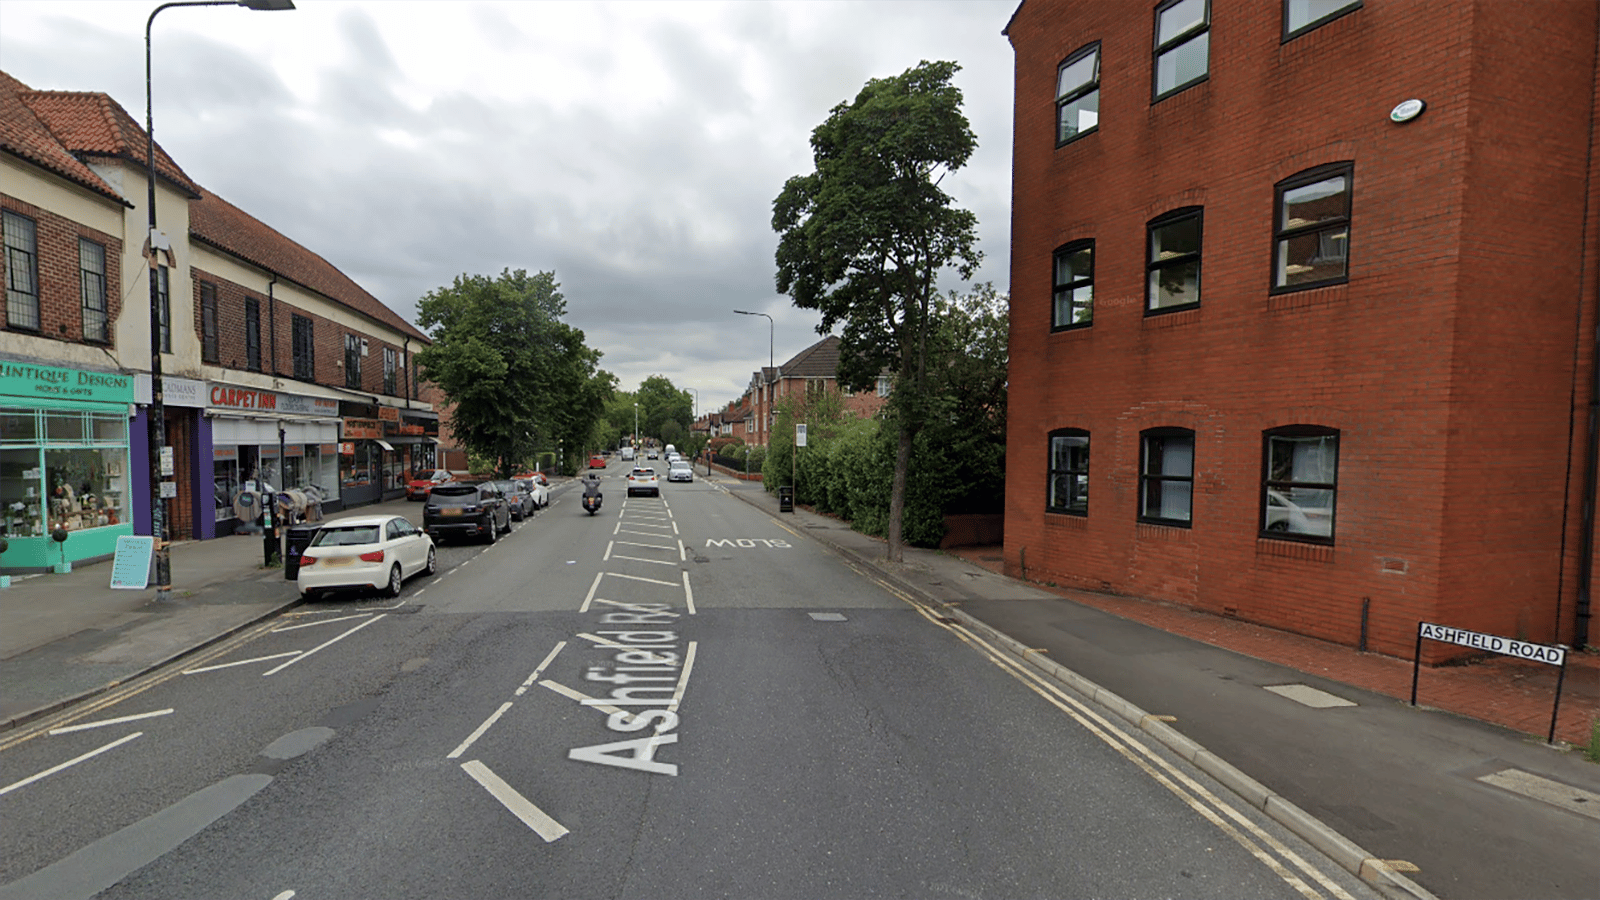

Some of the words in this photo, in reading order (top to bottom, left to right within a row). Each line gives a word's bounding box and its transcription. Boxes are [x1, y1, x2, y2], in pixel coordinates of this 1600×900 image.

[0, 362, 69, 383] INTIQUE
[211, 386, 257, 408] CARPET
[258, 392, 276, 409] INN
[705, 538, 792, 548] SLOW
[1423, 625, 1503, 651] ASHFIELD
[1509, 642, 1560, 663] ROAD
